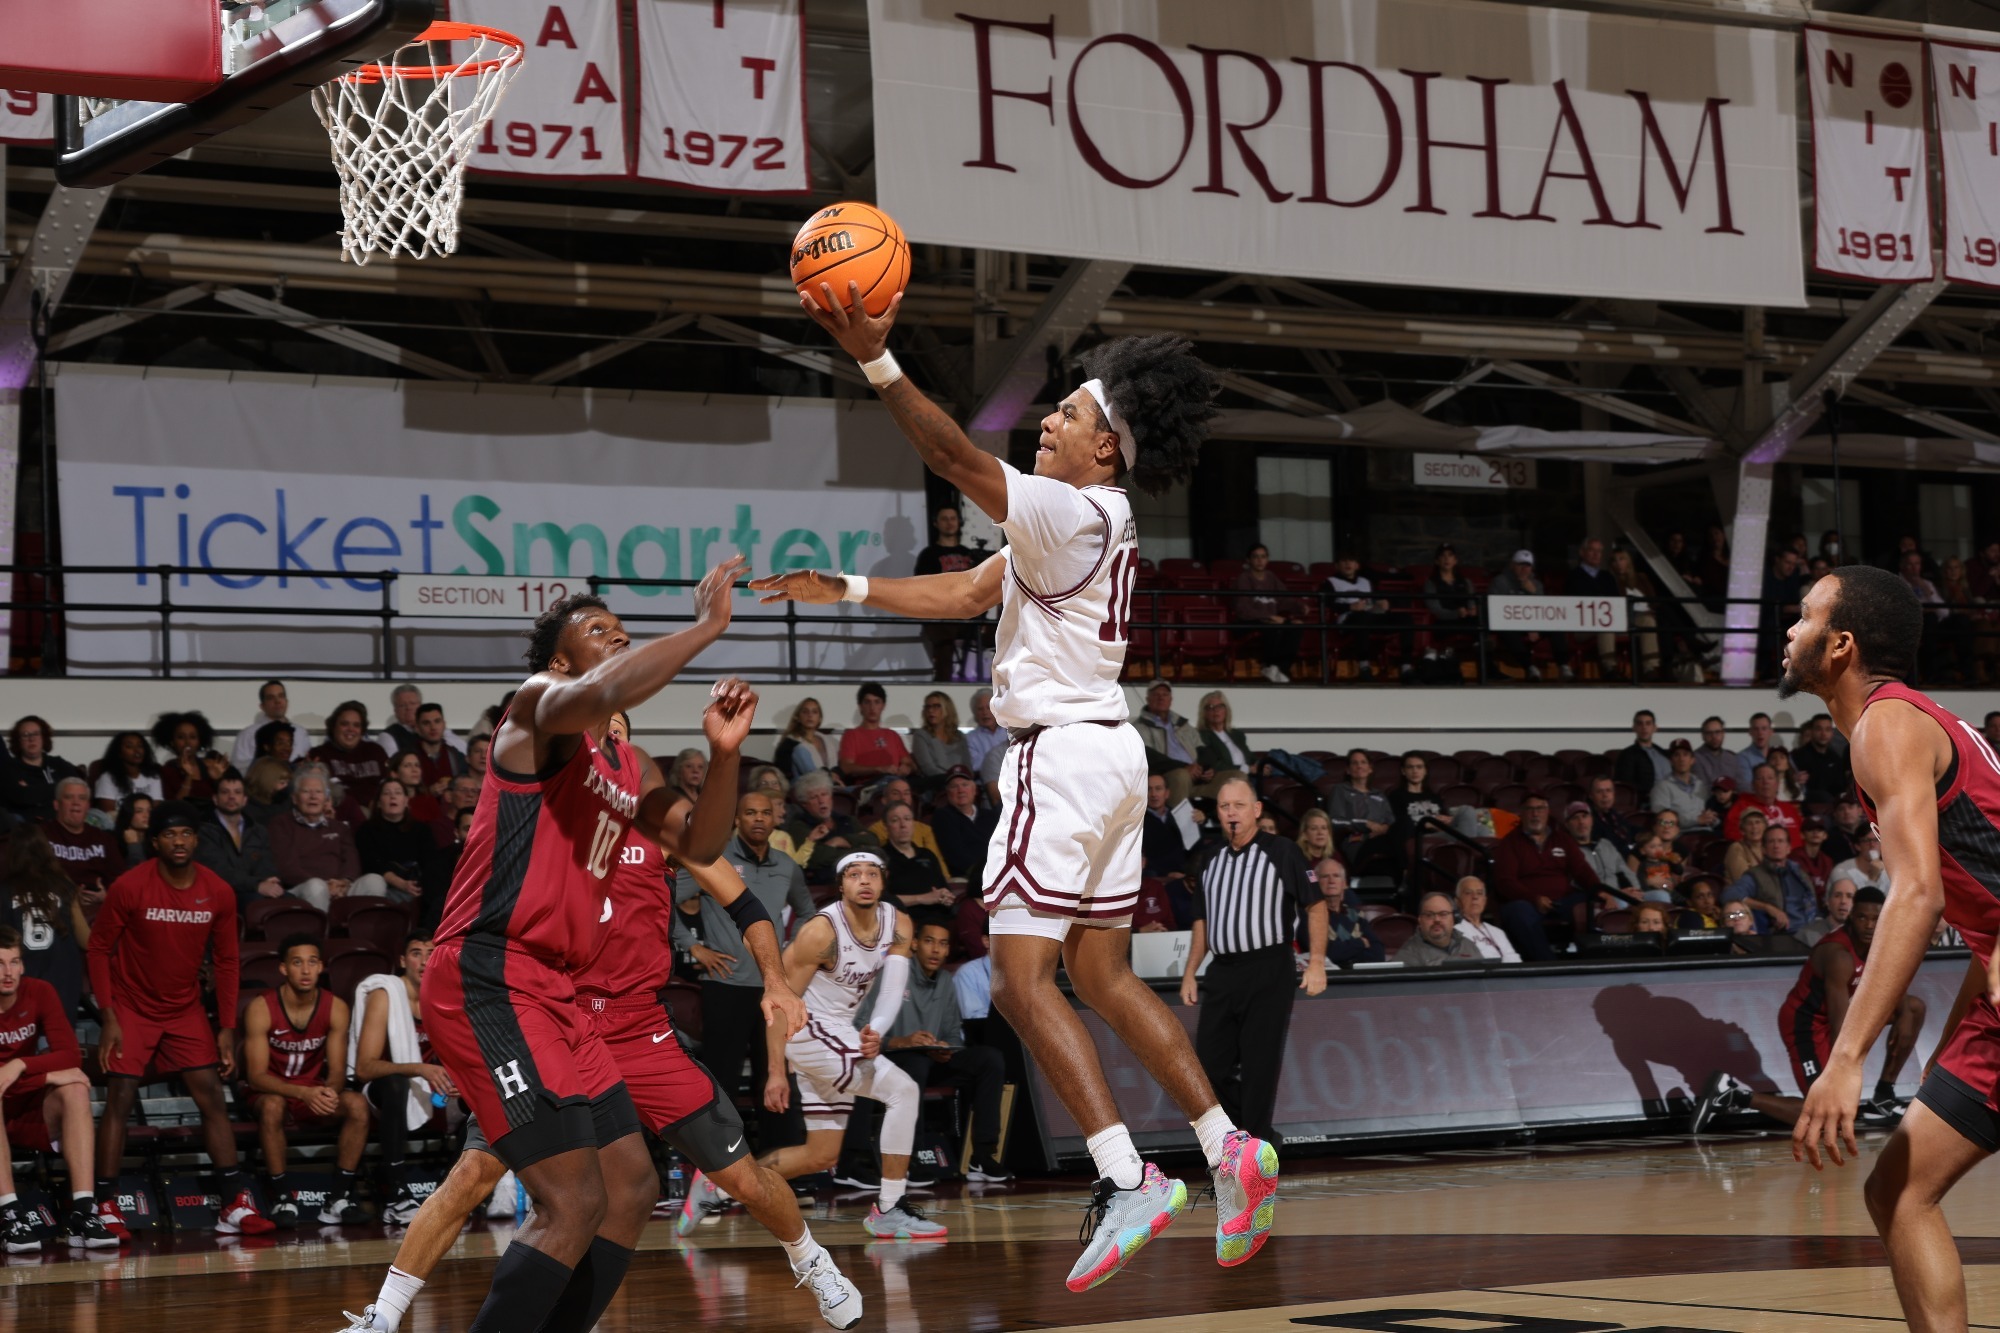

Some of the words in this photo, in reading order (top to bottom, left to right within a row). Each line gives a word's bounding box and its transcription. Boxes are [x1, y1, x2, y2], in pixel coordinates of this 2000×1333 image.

[536, 6, 578, 49] A
[573, 62, 617, 104] A
[741, 56, 776, 100] T
[477, 119, 602, 160] 1971
[954, 12, 1745, 236] FORDHAM
[663, 127, 786, 171] 1972
[1838, 227, 1914, 262] 1981
[1964, 236, 2000, 267] 19
[1424, 463, 1481, 477] SECTION
[1488, 460, 1526, 485] 213
[418, 586, 504, 605] SECTION
[517, 582, 568, 612] 112
[1503, 605, 1567, 621] SECTION
[1575, 601, 1613, 628] 113
[48, 841, 105, 860] ORDHAM
[587, 811, 621, 880] 10
[146, 907, 213, 924] HARVARD
[285, 1053, 305, 1077] 11
[494, 1059, 529, 1100] H
[1803, 1060, 1817, 1077] H
